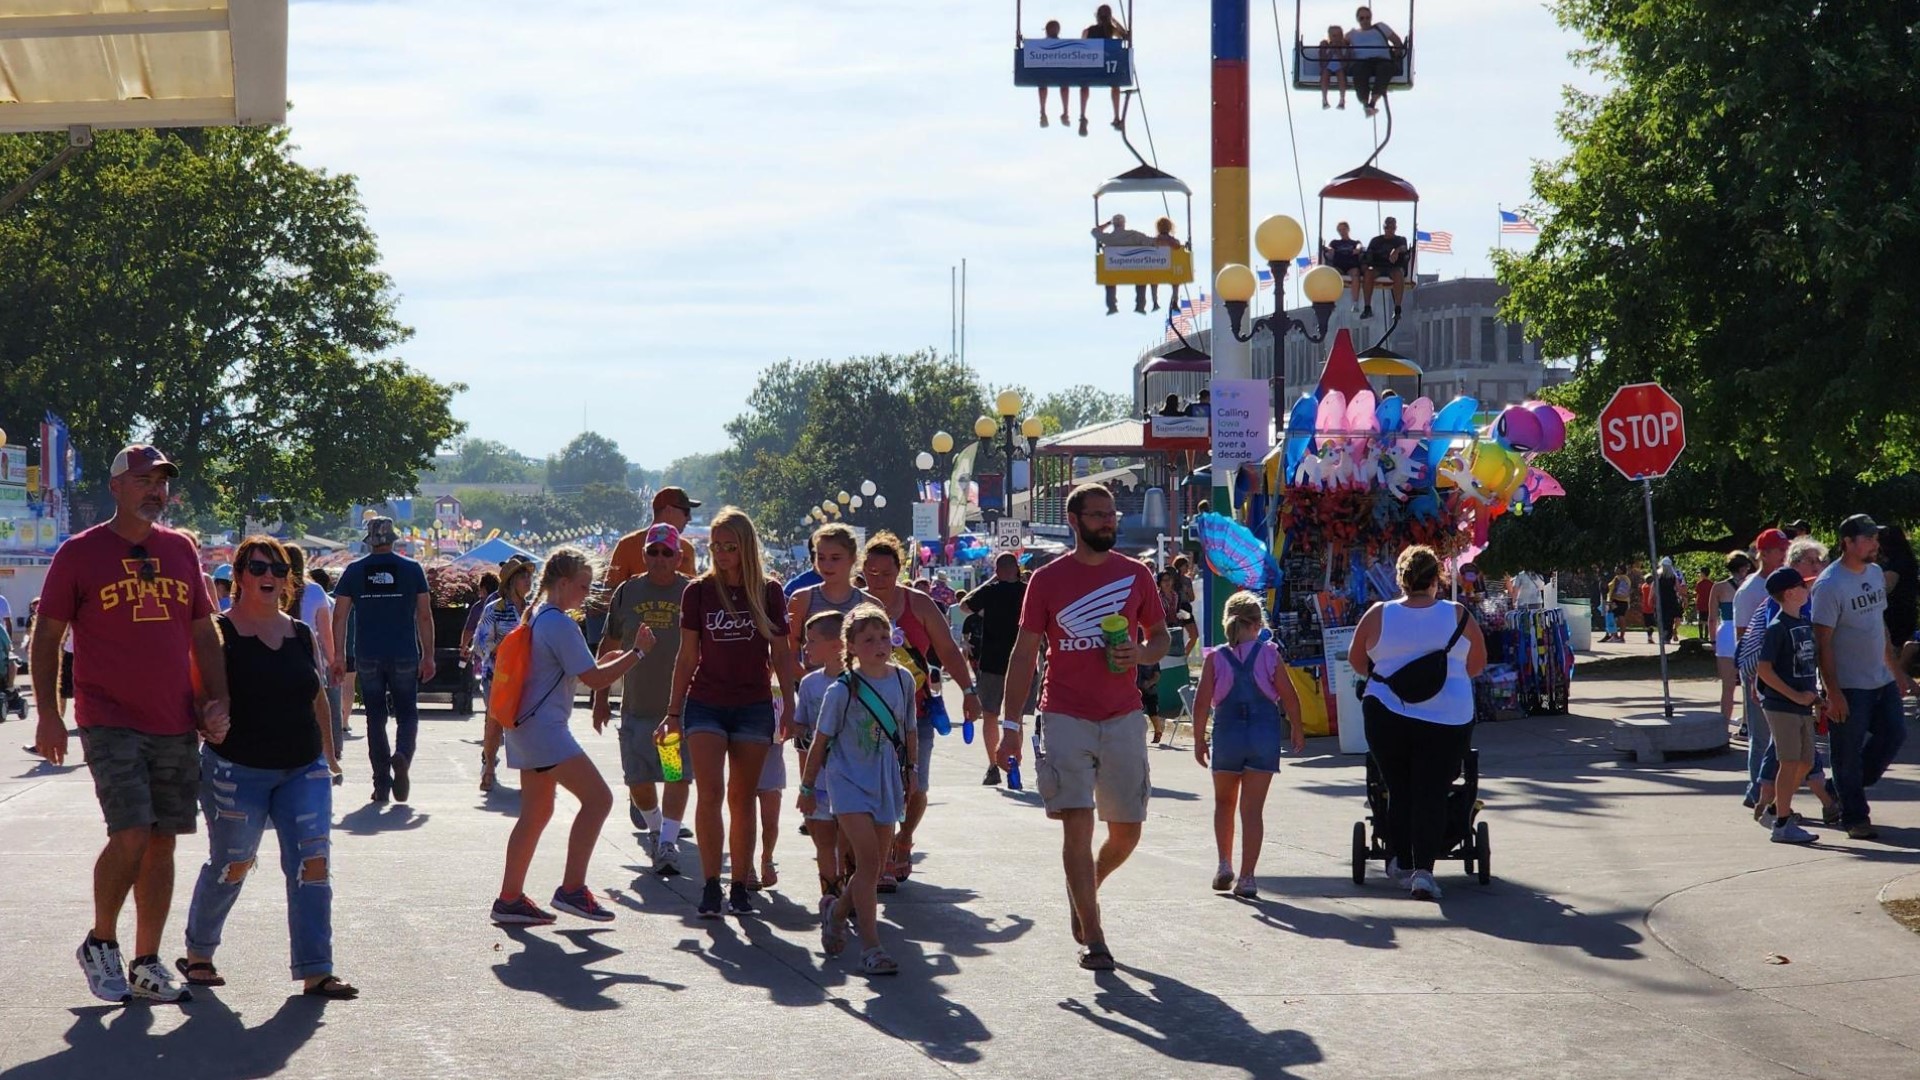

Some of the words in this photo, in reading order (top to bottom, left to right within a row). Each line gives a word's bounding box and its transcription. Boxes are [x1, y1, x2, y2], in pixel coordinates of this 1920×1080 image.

[1029, 51, 1098, 61] SuperiorSleep
[1106, 61, 1117, 73] 17
[1108, 255, 1167, 266] SuperiorSleep
[1217, 408, 1249, 419] Calling
[1156, 424, 1205, 433] SuperiorSleep
[1218, 419, 1240, 428] Iowa
[1218, 429, 1244, 438] home
[1246, 429, 1259, 438] for
[1608, 411, 1678, 452] STOP
[1218, 440, 1238, 448] over
[1240, 440, 1246, 448] a
[1217, 449, 1252, 459] decade
[1001, 535, 1020, 547] 20
[100, 577, 189, 611] STATE
[1060, 636, 1106, 651] HON
